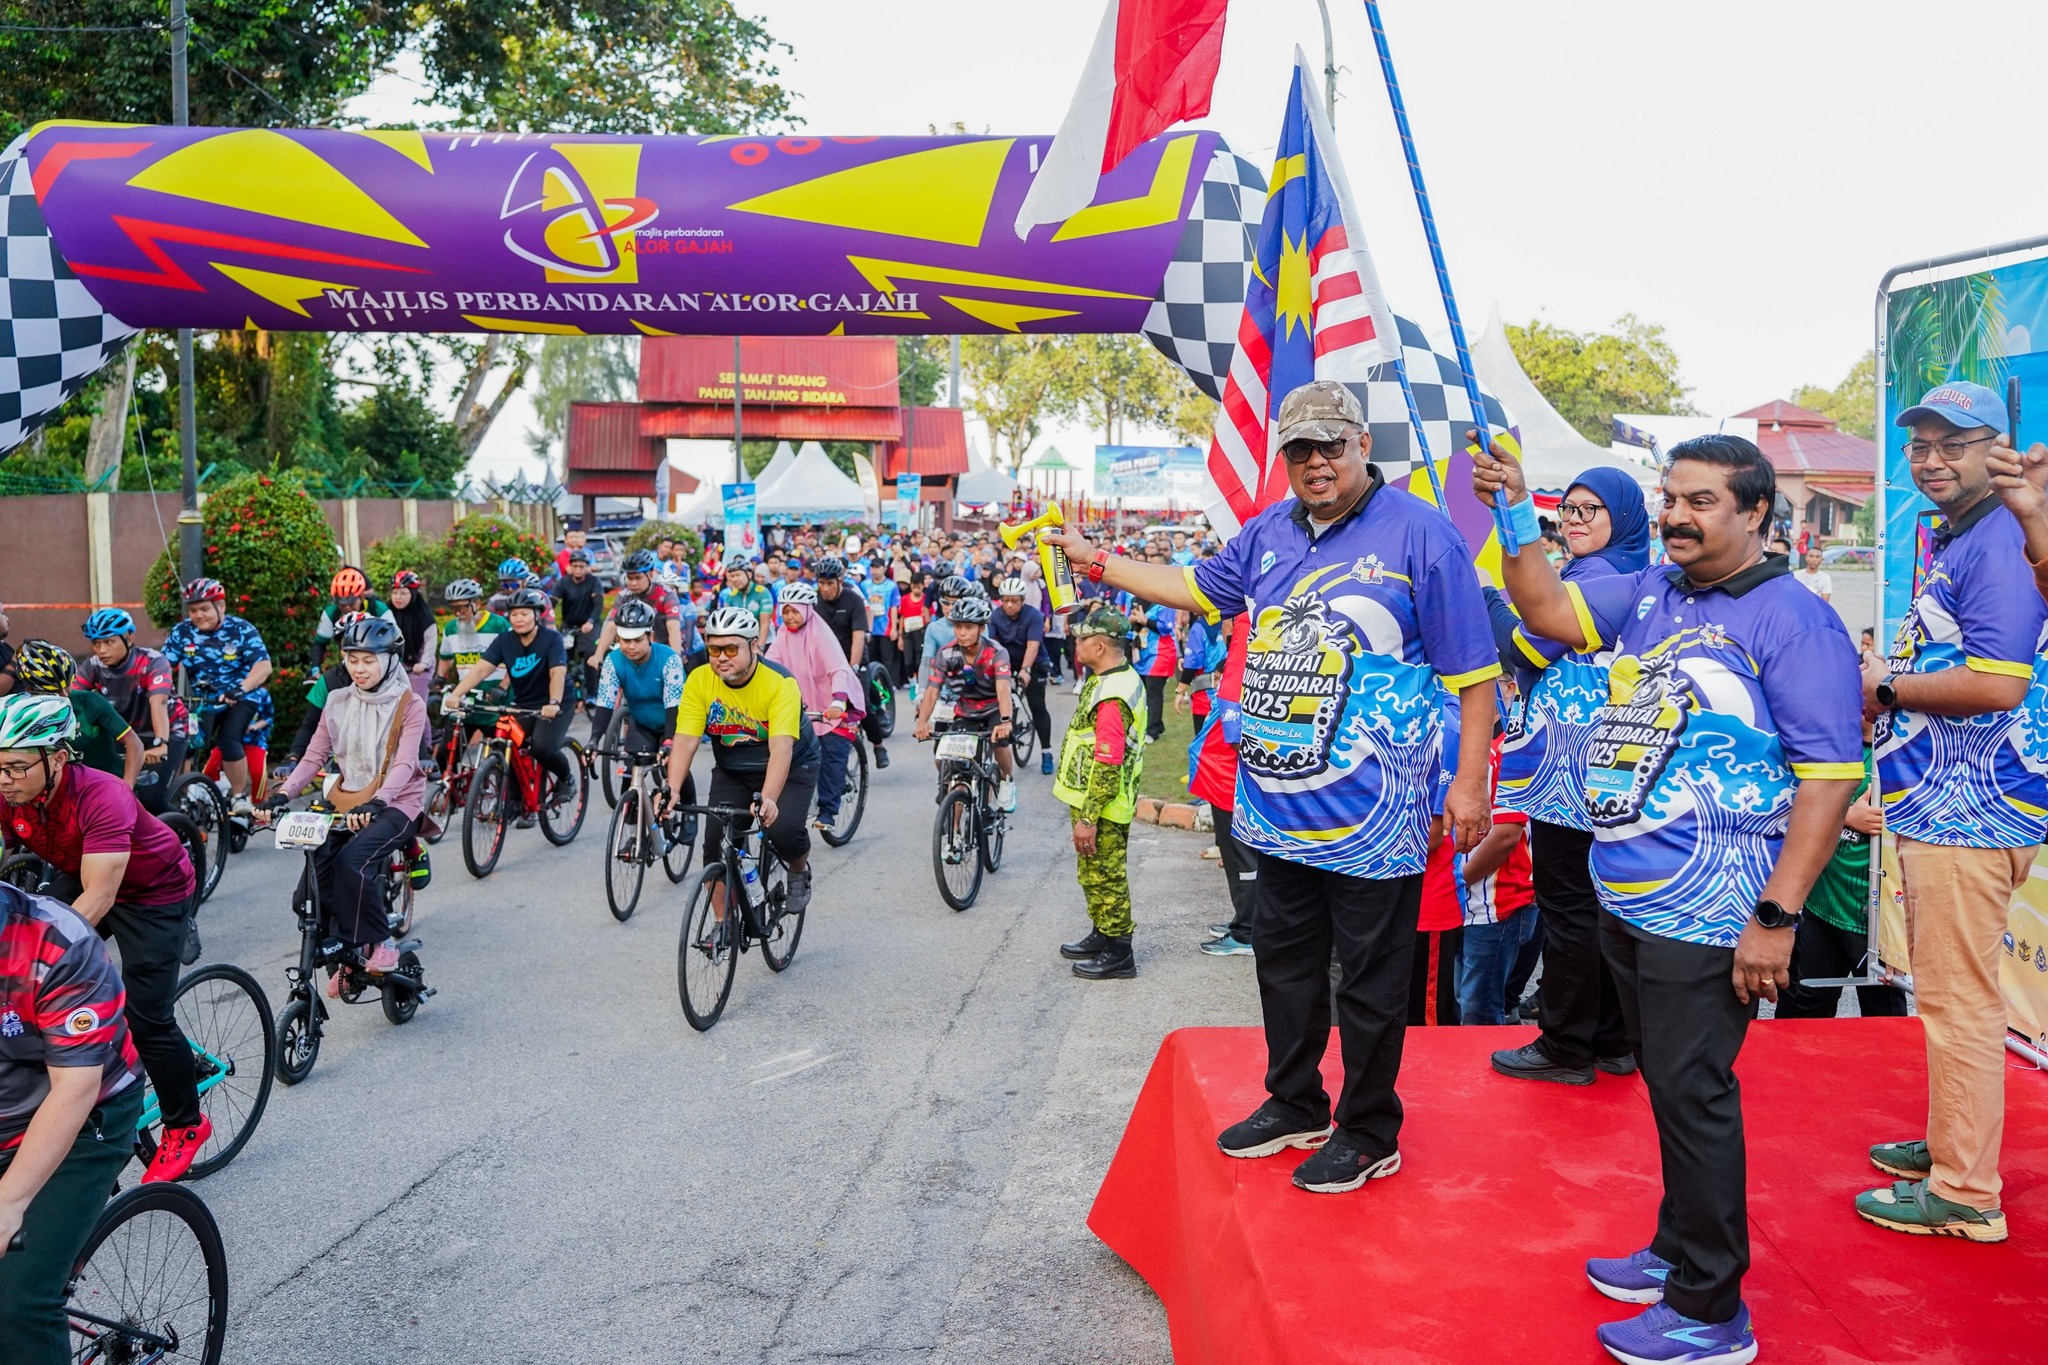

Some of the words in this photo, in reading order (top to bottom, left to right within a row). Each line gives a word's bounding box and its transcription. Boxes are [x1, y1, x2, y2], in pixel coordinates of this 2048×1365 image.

[635, 227, 662, 239] majlis
[664, 227, 724, 239] perbandaran
[623, 240, 671, 254] ALOR
[674, 239, 733, 254] GAJAH
[324, 290, 448, 311] MAJLIS
[454, 291, 701, 312] PERBANDARAN
[709, 292, 801, 312] ALOR
[807, 292, 919, 312] GAJAH
[777, 375, 827, 387] DATANG
[699, 387, 739, 399] PANTA
[743, 388, 799, 402] TANJUNG
[801, 391, 846, 403] BIDARA
[1261, 653, 1322, 672] PANTAI
[1268, 674, 1334, 694] BIDARA
[1243, 688, 1291, 718] 2025
[1607, 726, 1666, 745] BIDARA
[946, 743, 967, 753] 0009
[288, 825, 315, 839] 0040
